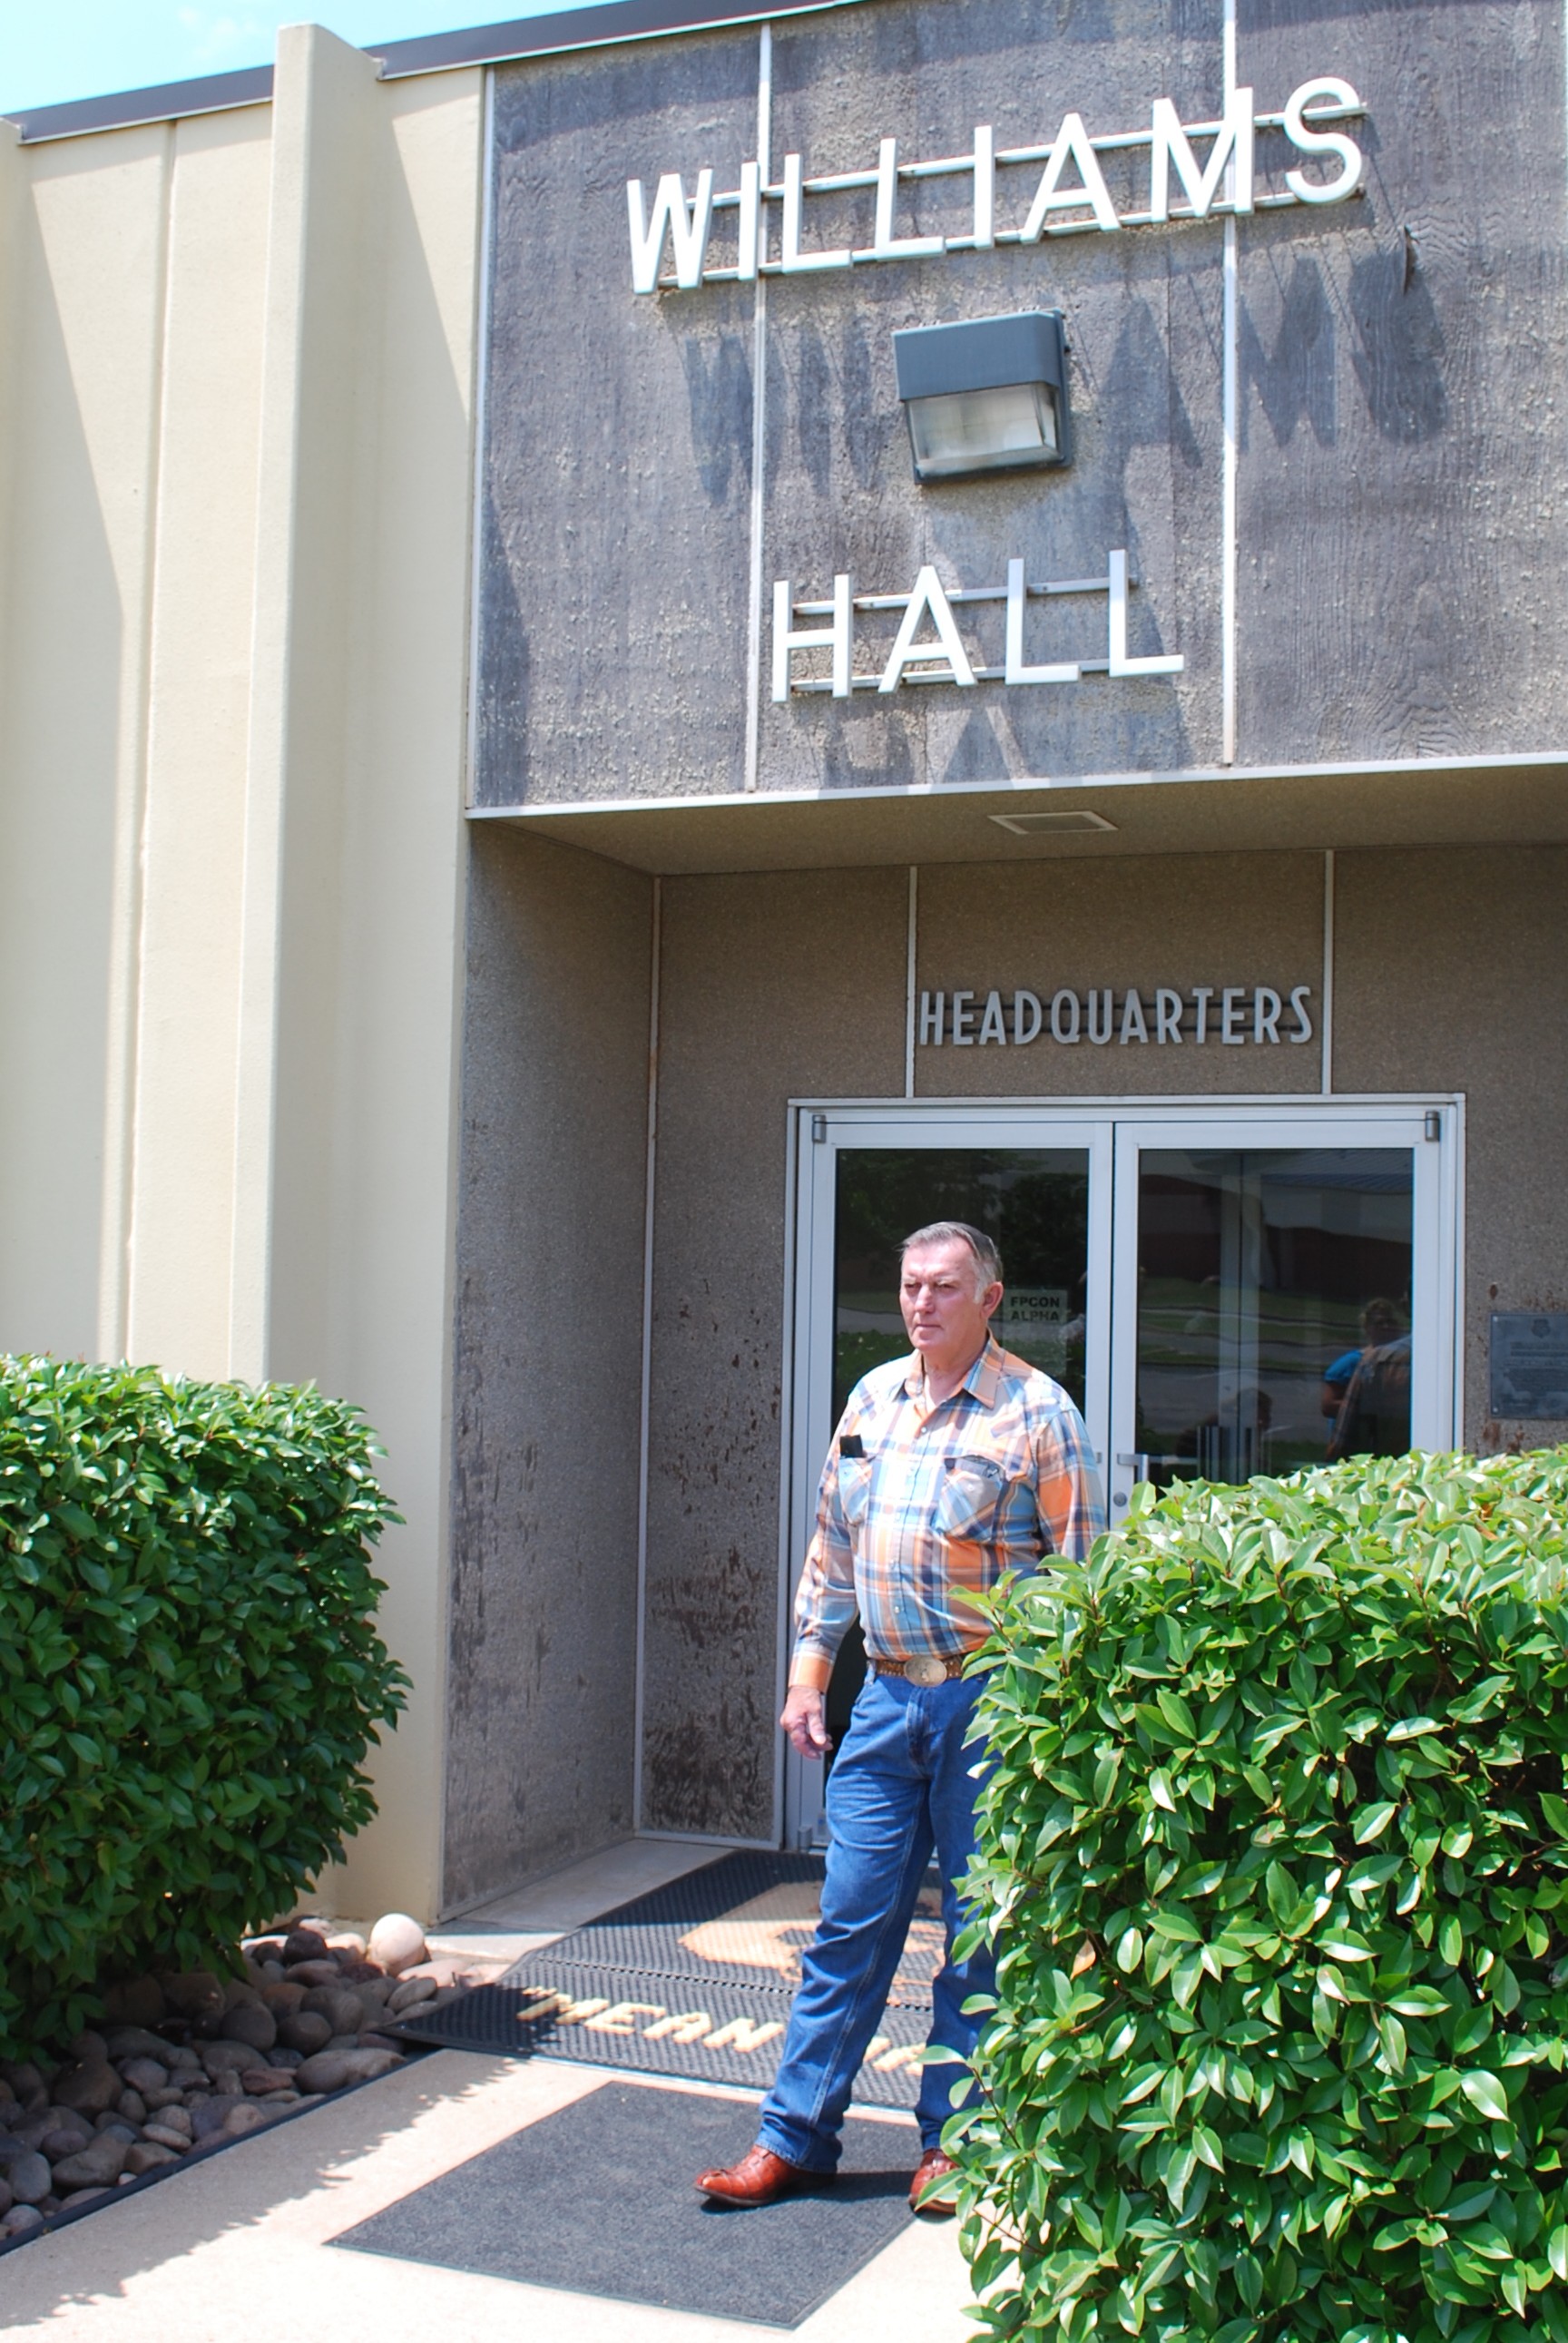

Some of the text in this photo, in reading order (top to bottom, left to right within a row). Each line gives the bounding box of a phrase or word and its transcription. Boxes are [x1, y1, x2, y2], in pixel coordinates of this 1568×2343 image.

[626, 77, 1363, 293] WILLIAMS
[772, 549, 1184, 702] HALL
[919, 986, 1312, 1045] HEADQUARTERS
[1011, 1297, 1060, 1308] FPCON
[1011, 1310, 1060, 1321] ALPHA
